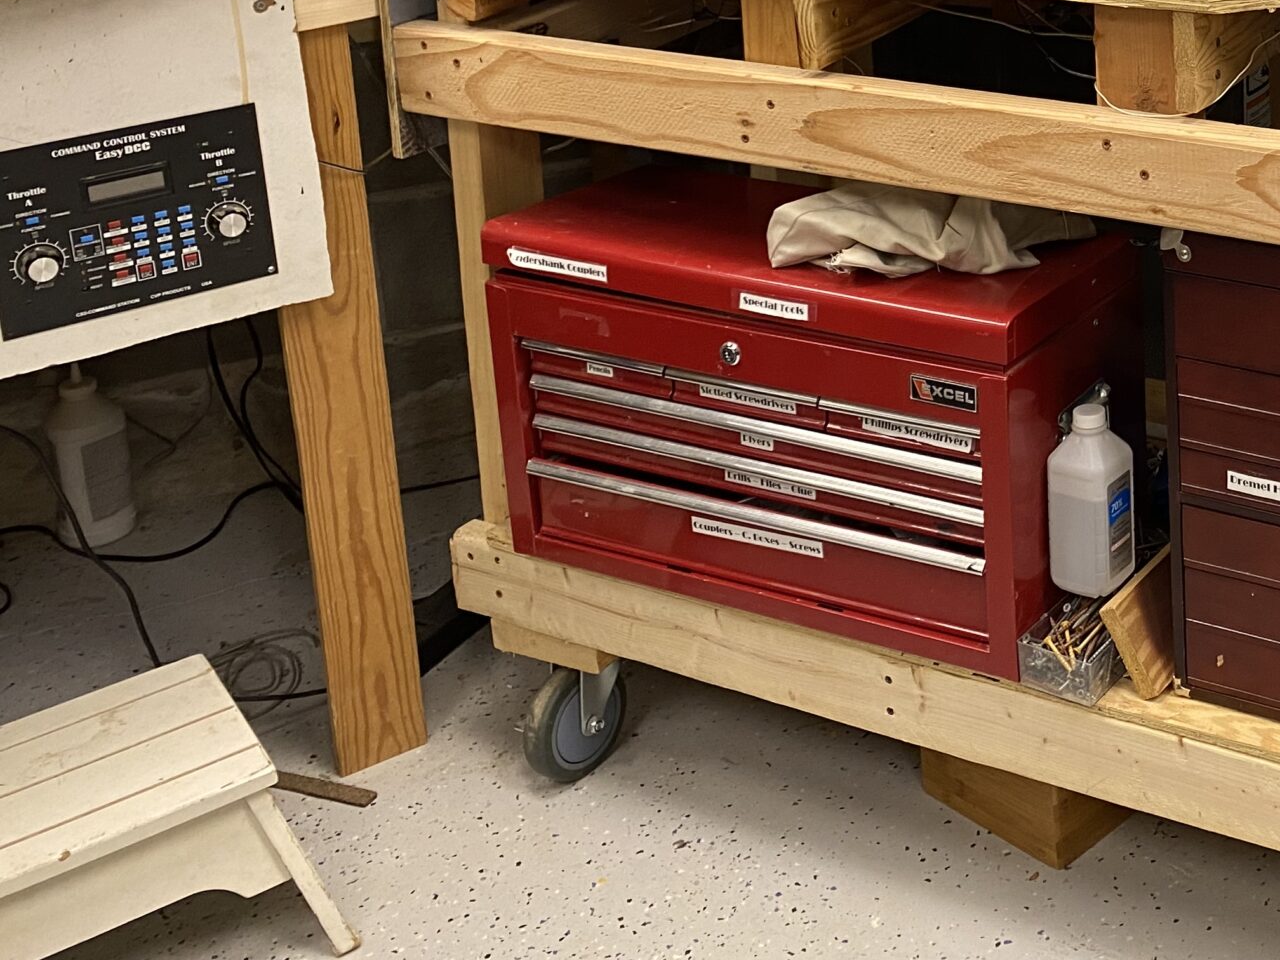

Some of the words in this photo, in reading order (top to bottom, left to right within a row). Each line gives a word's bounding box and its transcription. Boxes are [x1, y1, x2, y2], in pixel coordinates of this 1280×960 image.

[51, 142, 101, 158] COMMAND
[103, 133, 148, 147] CONTROL
[150, 125, 186, 139] SYSTEM
[95, 141, 151, 160] EasyDCC
[200, 147, 235, 160] Throttle
[215, 159, 223, 167] B
[6, 187, 47, 200] Throttle
[25, 199, 33, 207] A
[509, 252, 565, 270] ndershank
[567, 263, 606, 278] Couplers
[743, 296, 778, 310] Special
[780, 304, 804, 315] Tools
[700, 385, 733, 399] Slotted
[734, 392, 795, 412] Screwdrivers
[921, 382, 974, 404] EXCEL
[864, 416, 902, 433] Phillips
[903, 426, 969, 448] Screwdrivers
[1230, 474, 1271, 492] Dremel
[1111, 498, 1123, 513] 70%
[693, 521, 733, 537] Couplers
[753, 533, 780, 546] Boxes
[789, 541, 822, 554] Screws
